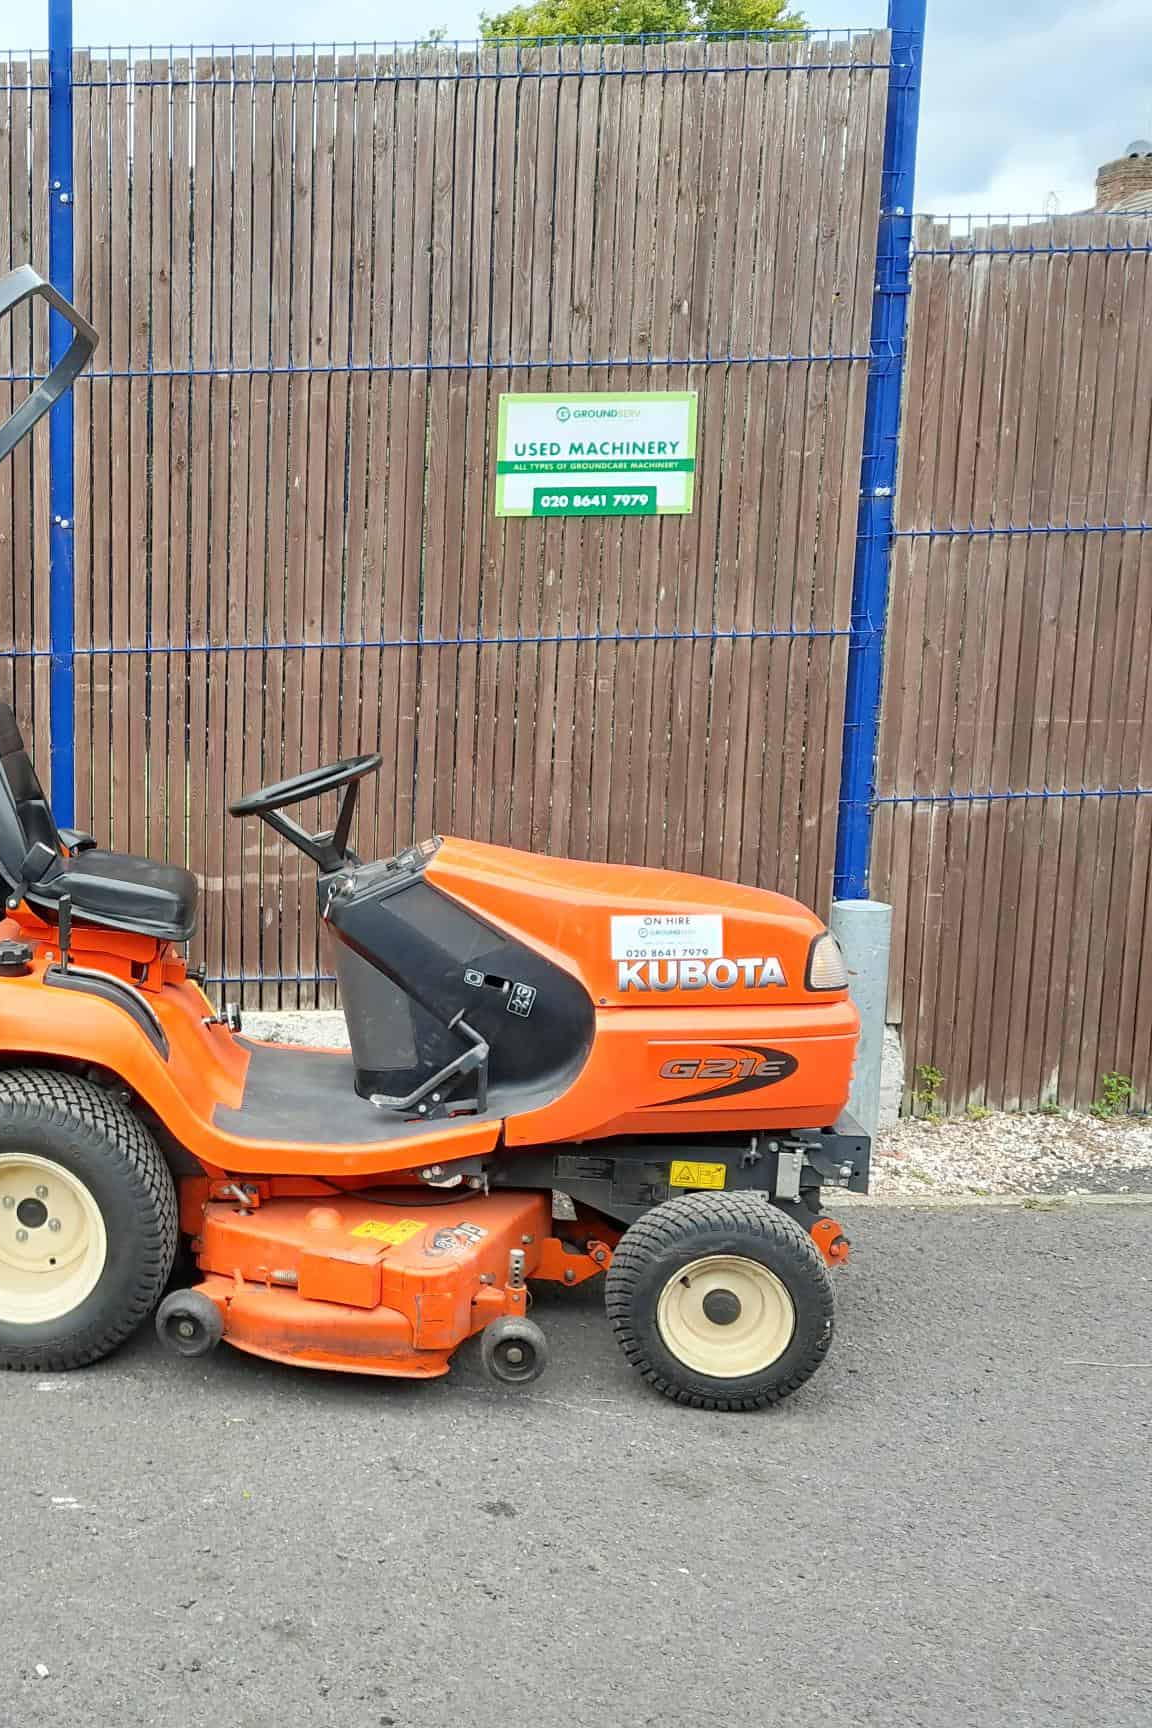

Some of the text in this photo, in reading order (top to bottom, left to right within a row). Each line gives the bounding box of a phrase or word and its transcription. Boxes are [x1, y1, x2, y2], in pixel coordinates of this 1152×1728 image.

[514, 441, 680, 457] USED MACHINERY
[513, 463, 527, 471] ALL
[530, 463, 554, 471] TYPES
[570, 462, 627, 471] GROUNDCARE
[631, 462, 679, 470] MACHINERY
[541, 494, 648, 507] 020 8641 7979
[644, 916, 691, 926] ON HIRE
[626, 948, 709, 958] 020 8641 7979
[617, 957, 788, 992] KUBOTA
